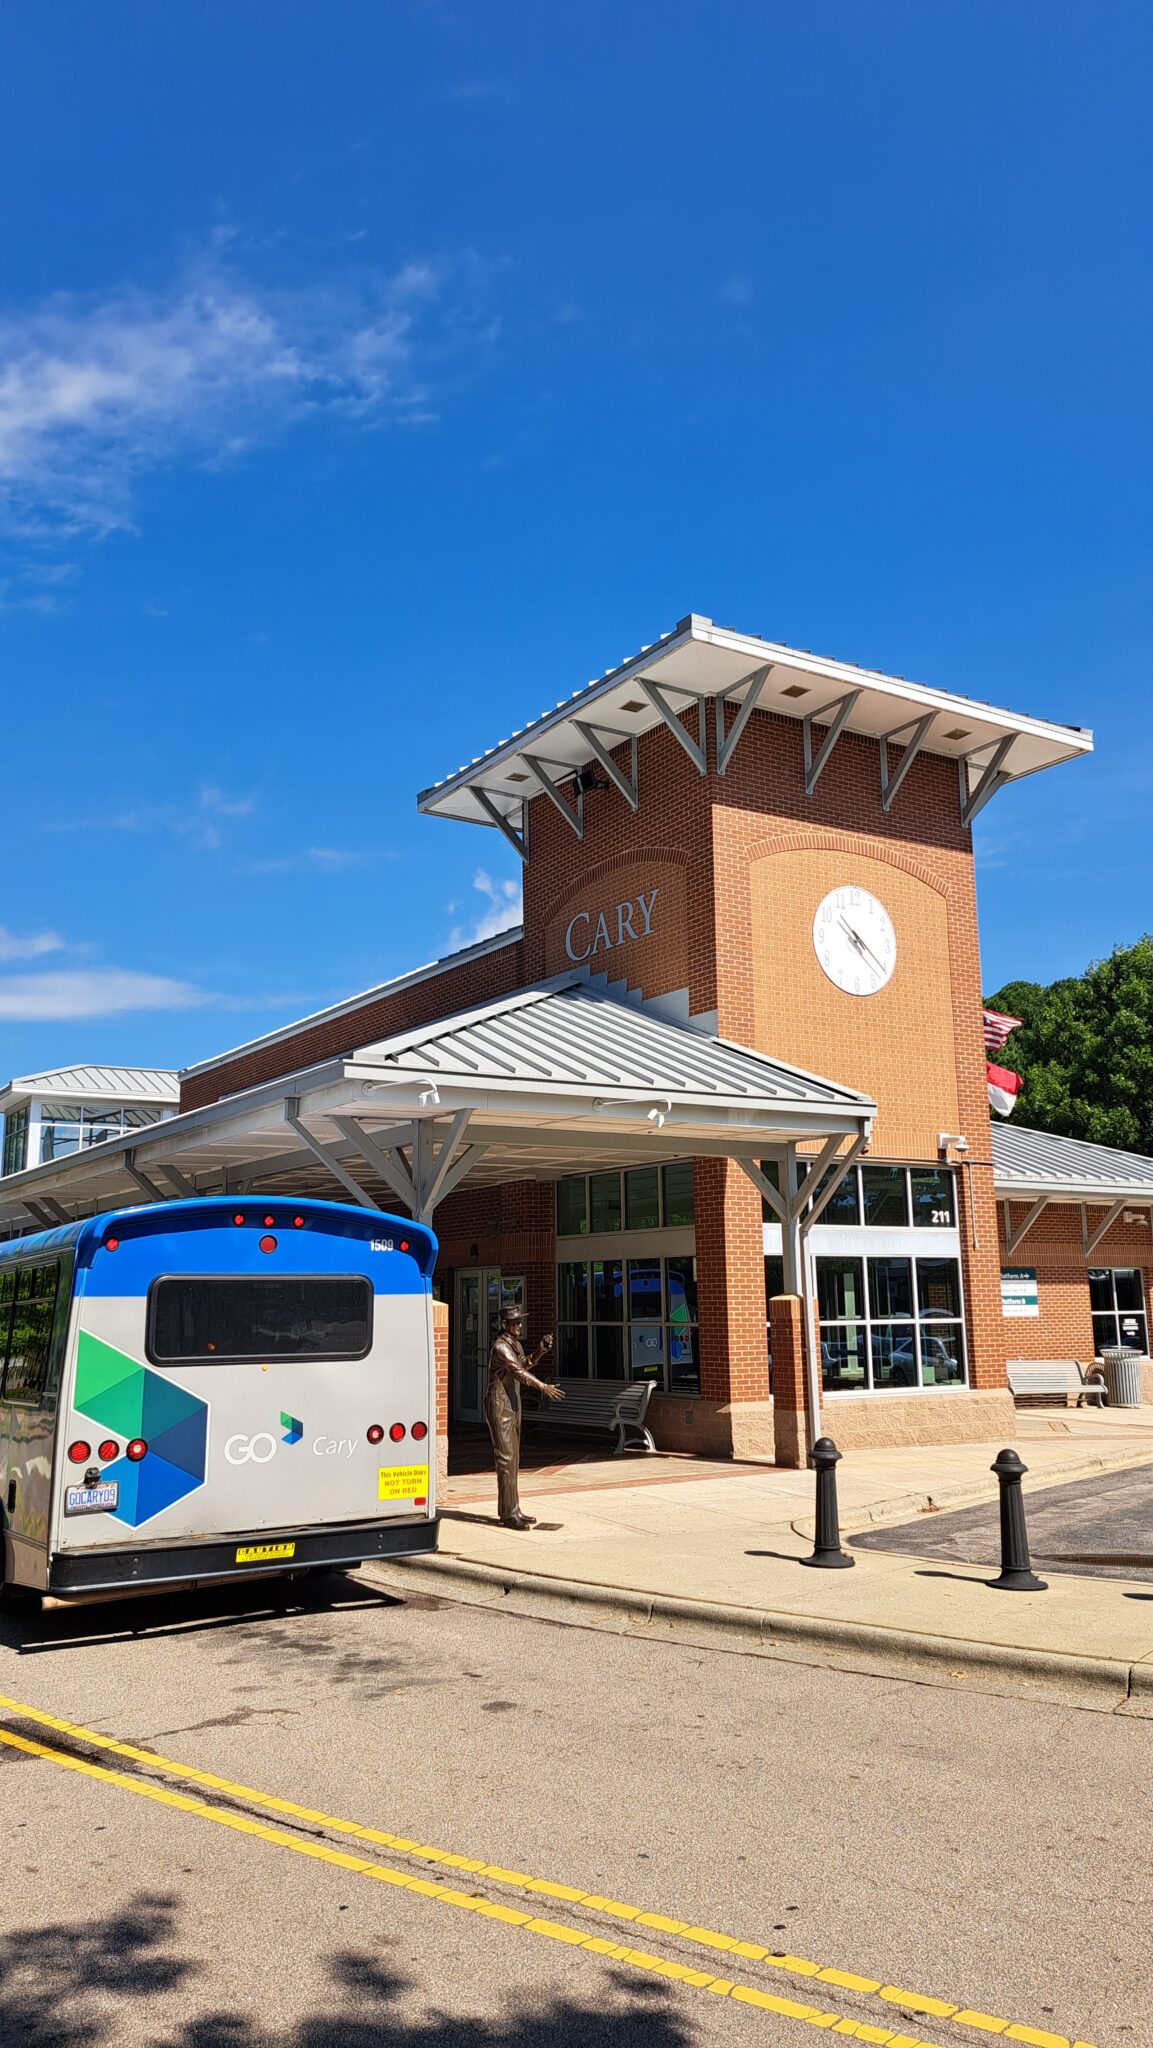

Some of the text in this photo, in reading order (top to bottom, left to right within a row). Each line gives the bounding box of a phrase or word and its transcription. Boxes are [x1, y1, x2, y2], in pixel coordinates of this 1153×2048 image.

[835, 893, 845, 910] 11
[849, 890, 861, 906] 12
[822, 906, 832, 923] 10
[868, 899, 874, 914] 1
[565, 888, 660, 961] CARY
[879, 916, 886, 932] 2
[818, 927, 825, 944] 9
[885, 938, 891, 954] 3
[824, 950, 830, 967] 8
[837, 969, 843, 985] 7
[854, 976, 860, 993] 6
[870, 973, 877, 989] 5
[931, 1210, 950, 1223] 211
[368, 1238, 394, 1251] 1509
[224, 1432, 277, 1465] GO
[312, 1436, 358, 1458] Cary
